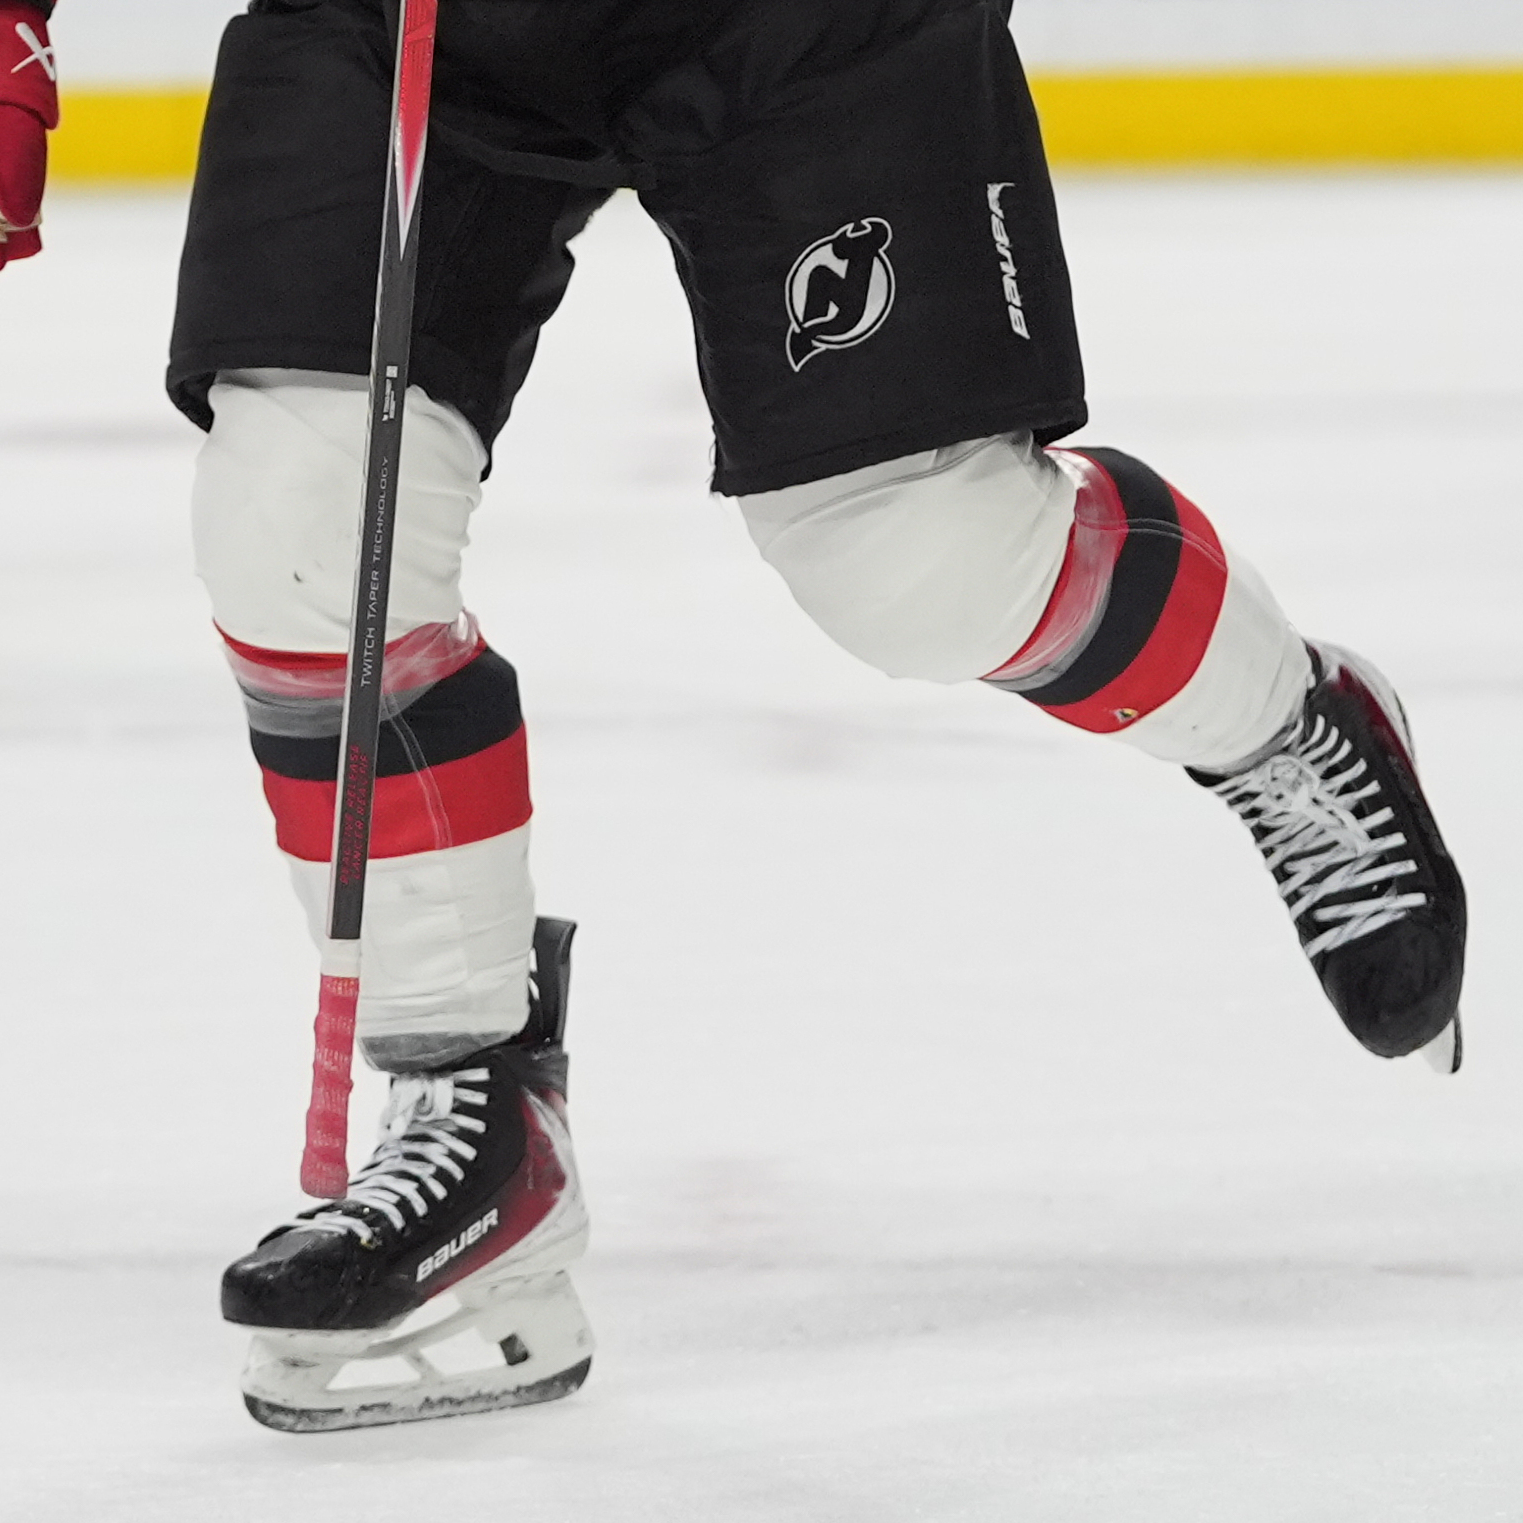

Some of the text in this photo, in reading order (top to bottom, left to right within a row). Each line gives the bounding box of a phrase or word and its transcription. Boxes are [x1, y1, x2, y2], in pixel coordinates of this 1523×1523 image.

[360, 455, 389, 688] TWITCH TAPER TECHNOLOGY
[414, 1207, 499, 1284] BAUER
